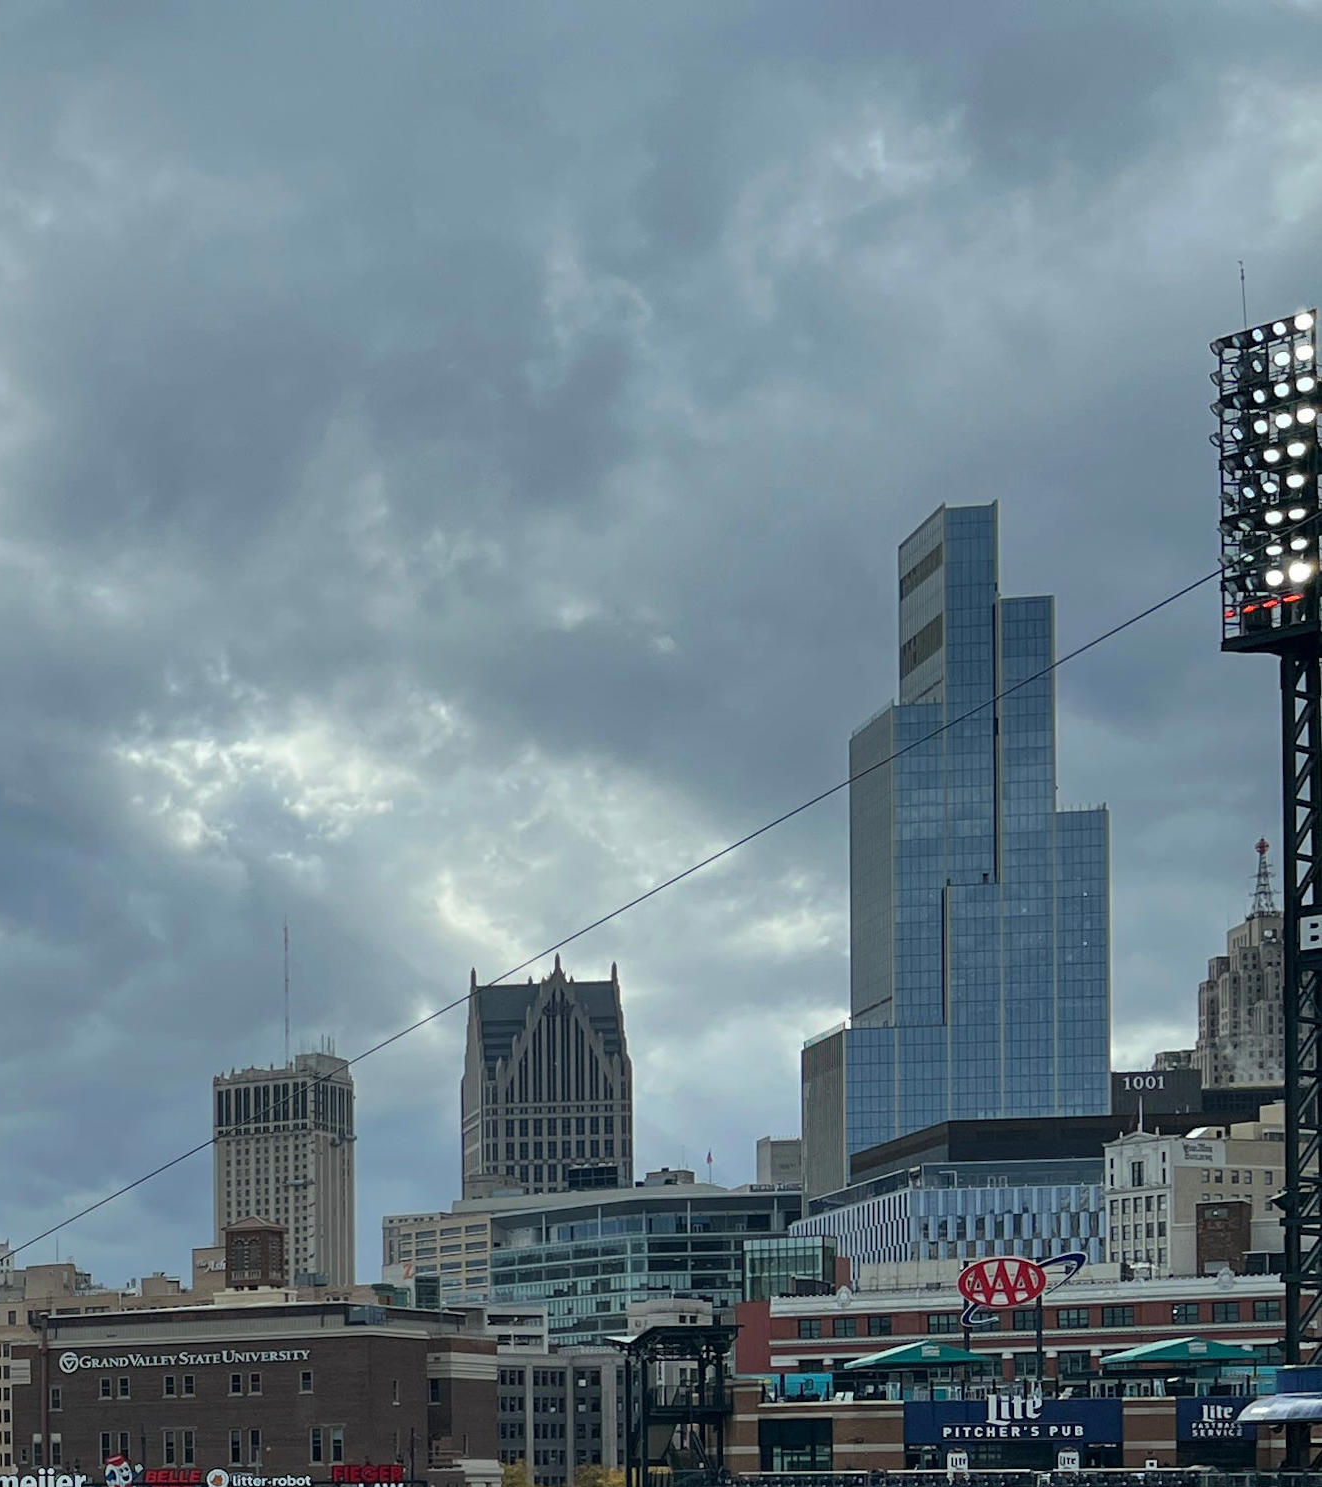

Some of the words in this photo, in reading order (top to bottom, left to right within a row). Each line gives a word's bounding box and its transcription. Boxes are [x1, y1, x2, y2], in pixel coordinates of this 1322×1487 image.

[1123, 1076, 1165, 1091] 1001
[968, 1260, 1038, 1306] AAA
[79, 1355, 128, 1368] GRAND
[128, 1353, 177, 1367] VALLEY
[178, 1352, 221, 1365] STATE
[222, 1350, 310, 1363] UNIVERSITY
[985, 1394, 1043, 1425] Lite
[1202, 1404, 1233, 1422] Lite
[943, 1426, 1040, 1437] PITCHER'S
[1049, 1425, 1084, 1436] PUB
[1192, 1429, 1243, 1437] SERVICE
[145, 1468, 201, 1483] BELLE
[333, 1465, 404, 1482] FIEGER
